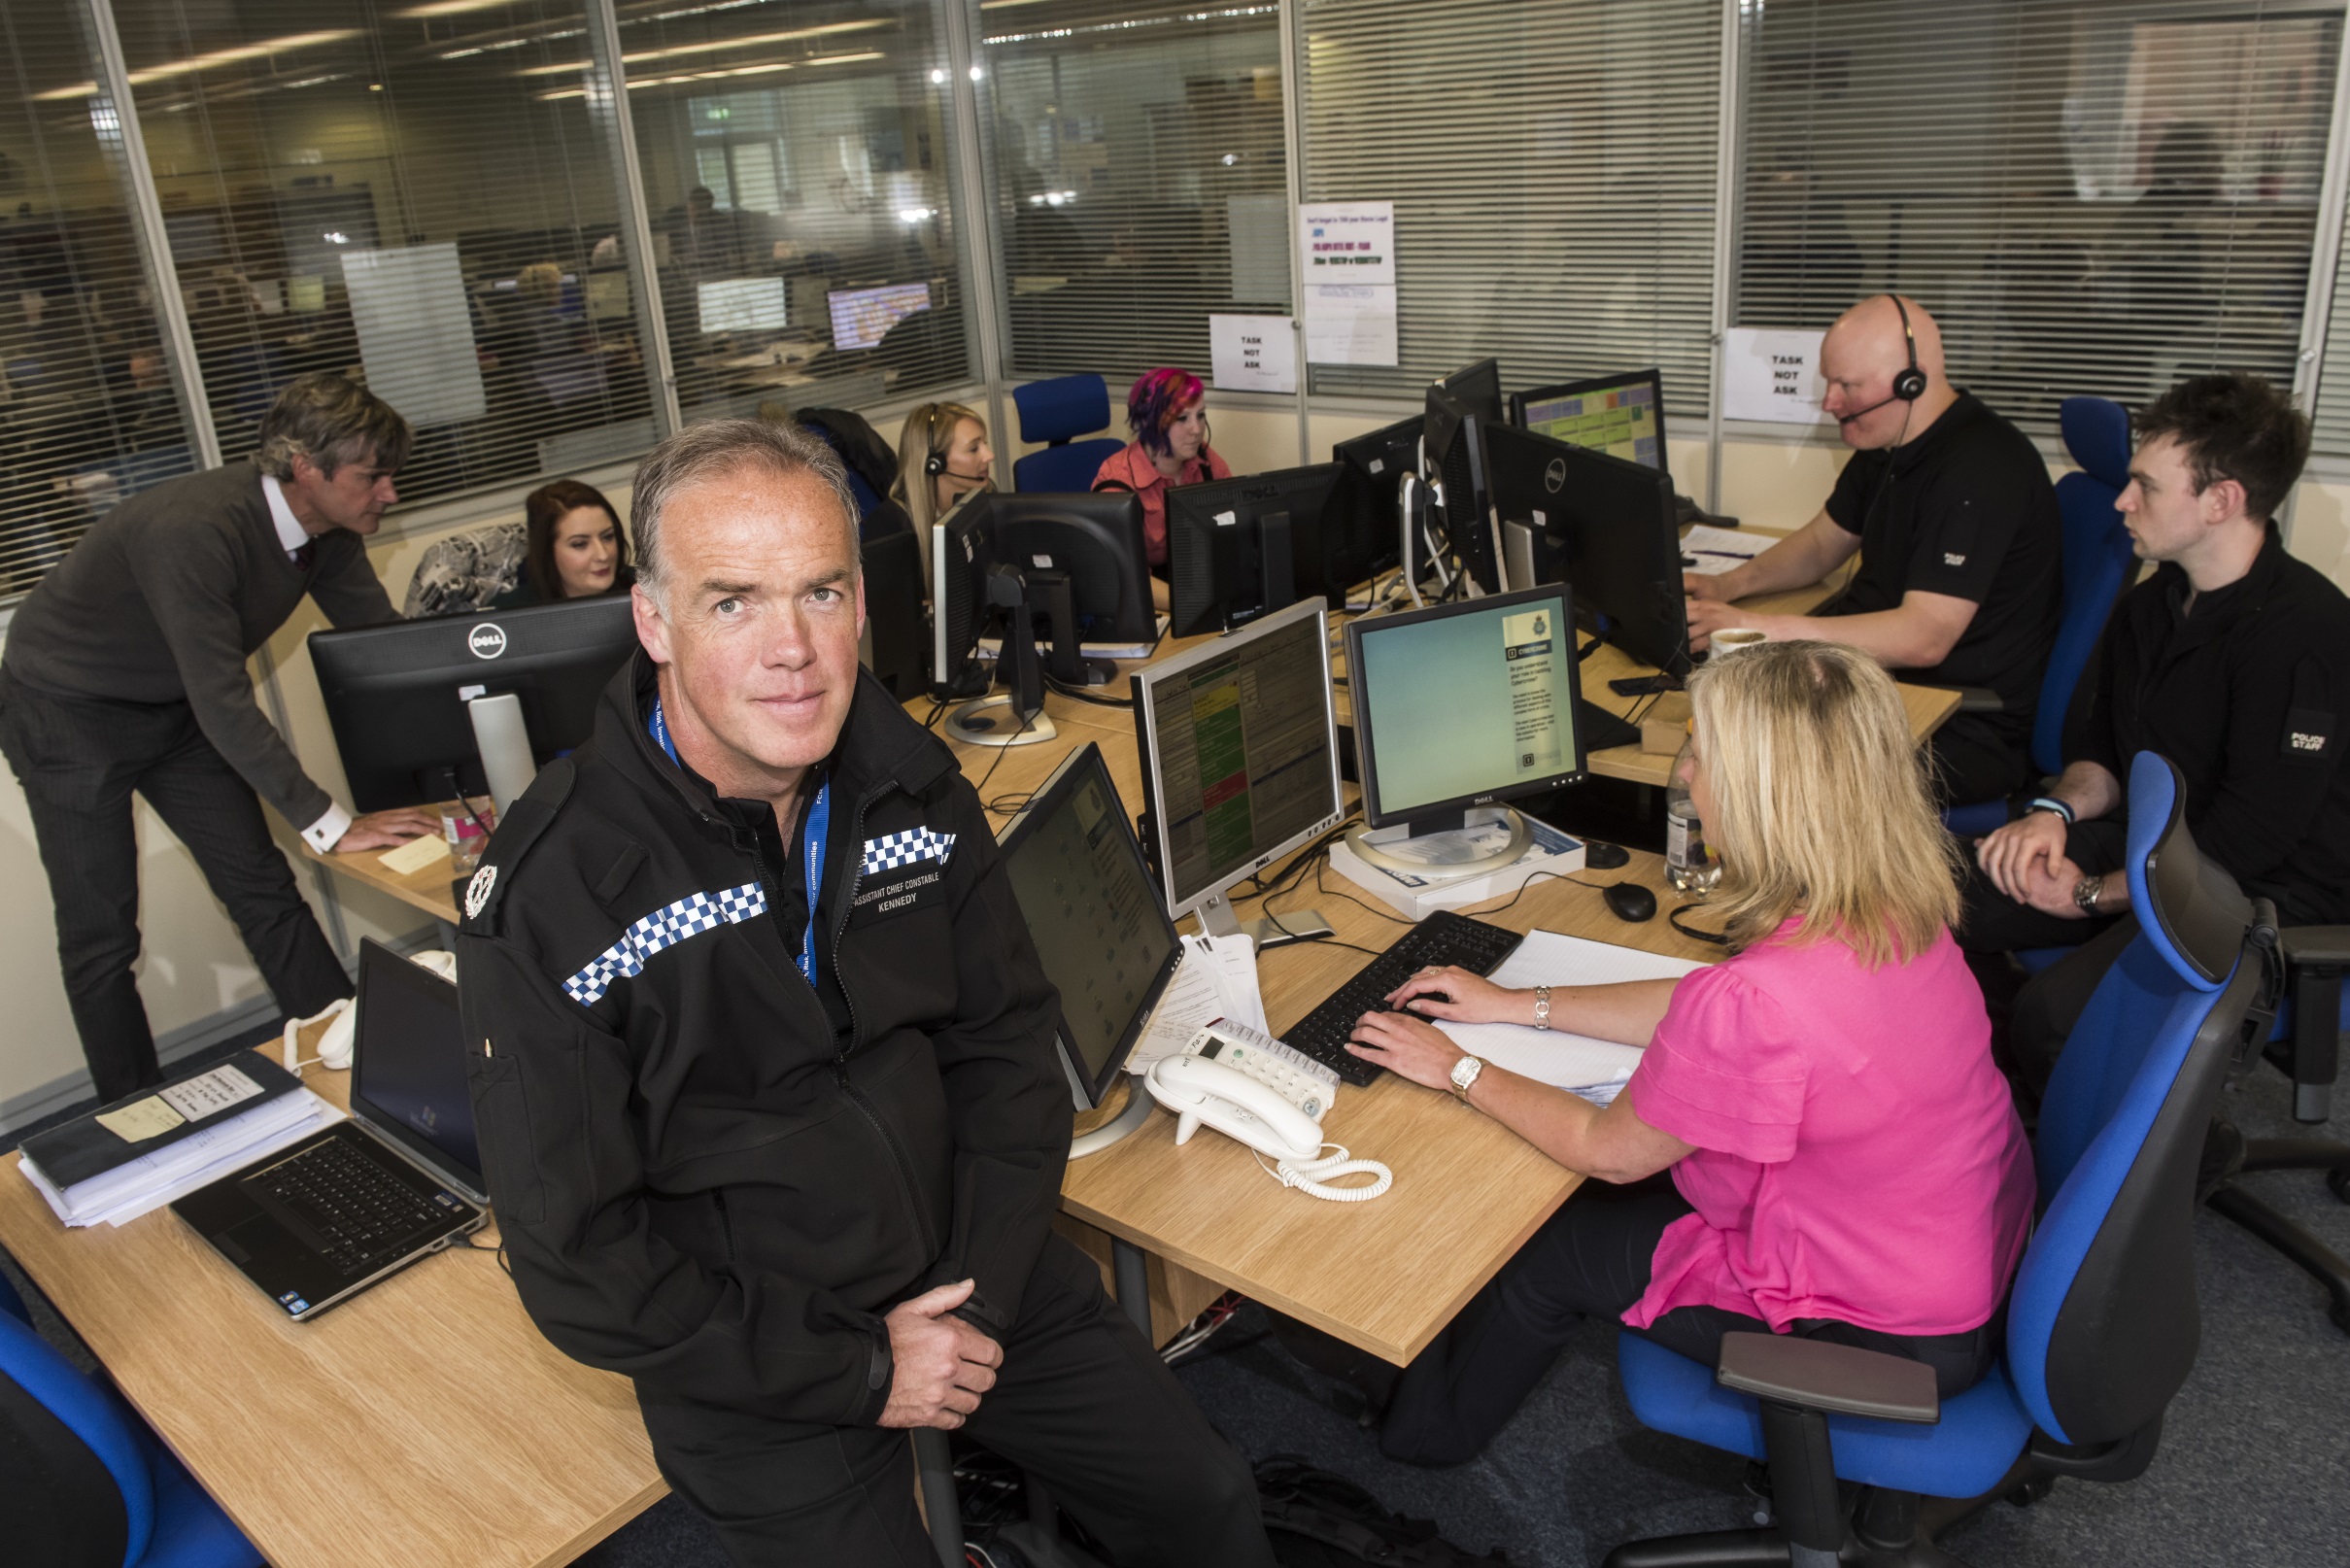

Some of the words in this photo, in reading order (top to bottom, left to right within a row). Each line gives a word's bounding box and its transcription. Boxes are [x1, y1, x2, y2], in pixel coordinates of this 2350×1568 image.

[1241, 335, 1262, 345] TASK
[1772, 355, 1804, 365] TASK
[1773, 371, 1799, 380] NOT
[1773, 385, 1798, 395] ASK
[473, 634, 503, 648] DELL
[2291, 732, 2326, 744] POLICE
[1474, 795, 1494, 805] DELL
[854, 887, 886, 907] ASSISTANT
[886, 883, 903, 896] CHIEF
[904, 871, 939, 890] CONSTABLE
[878, 892, 917, 913] KENNEDY
